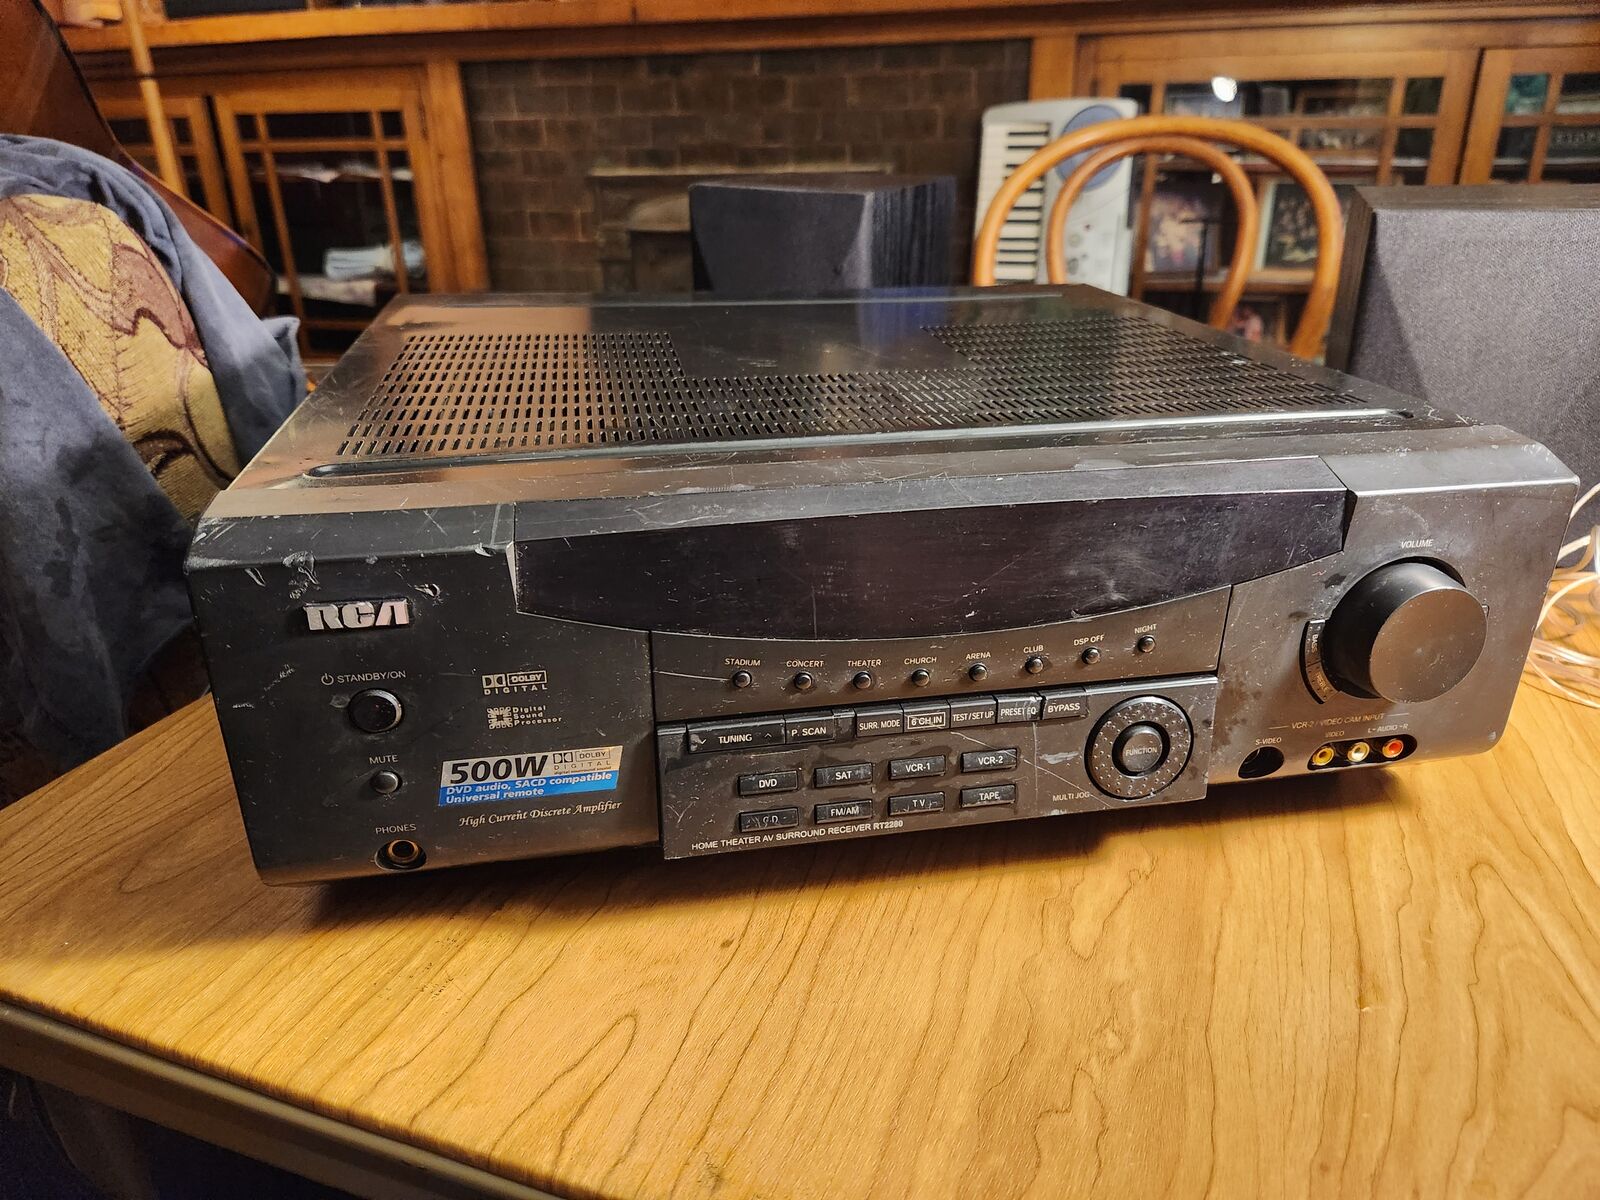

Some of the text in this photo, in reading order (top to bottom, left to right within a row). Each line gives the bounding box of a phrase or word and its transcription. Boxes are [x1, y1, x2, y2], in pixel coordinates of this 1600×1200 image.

[1401, 538, 1433, 549] VOLUME
[303, 598, 410, 631] RCA
[1134, 623, 1157, 634] NIGHT
[1073, 634, 1105, 646] DSP OFF
[1023, 645, 1044, 654] CLUB
[904, 656, 937, 665] CHURCH
[965, 651, 991, 661] ARENA
[724, 657, 761, 667] STADIUM
[786, 659, 825, 668] CONCERT
[847, 658, 882, 668] THEATER
[337, 670, 407, 684] STANDBY/ON
[511, 673, 542, 683] DOLBY
[484, 683, 548, 695] DIGITAL
[512, 705, 546, 714] Digital
[1000, 707, 1025, 716] PRESET
[1047, 702, 1081, 714] BYPASS
[513, 712, 543, 720] Sound
[984, 710, 995, 719] UP
[1344, 715, 1362, 723] CAM
[1362, 713, 1385, 721] INPUT
[513, 717, 562, 726] Processor
[859, 719, 901, 731] SURR. MODE
[911, 715, 943, 726] 6 CH IN
[791, 726, 827, 737] P. SCAN
[1325, 730, 1345, 738] VIDEO
[1377, 724, 1397, 733] AUDIO
[718, 733, 753, 744] TUNING
[1255, 736, 1282, 746] S-VIDEO
[579, 751, 606, 759] DOLBY
[1125, 747, 1157, 757] FUNCTION
[369, 754, 399, 765] MUTE
[977, 755, 1003, 766] VCR-2
[450, 755, 548, 784] 500W
[554, 760, 611, 771] DIGITAL
[905, 762, 930, 773] VCR-1
[835, 770, 852, 780] SAT
[446, 772, 613, 795] DVD audio, SACD compatible
[758, 779, 777, 788] DVD
[446, 788, 544, 804] Universal remote
[979, 791, 1000, 801] TAPE
[1052, 791, 1091, 802] MULTI JOG
[459, 801, 622, 828] High Current Discrete Amplifier
[830, 805, 860, 817] FM/AM
[375, 823, 417, 835] PHONES
[691, 819, 904, 850] HOME THEATER AV SURROUND RECEIVER RT2280
